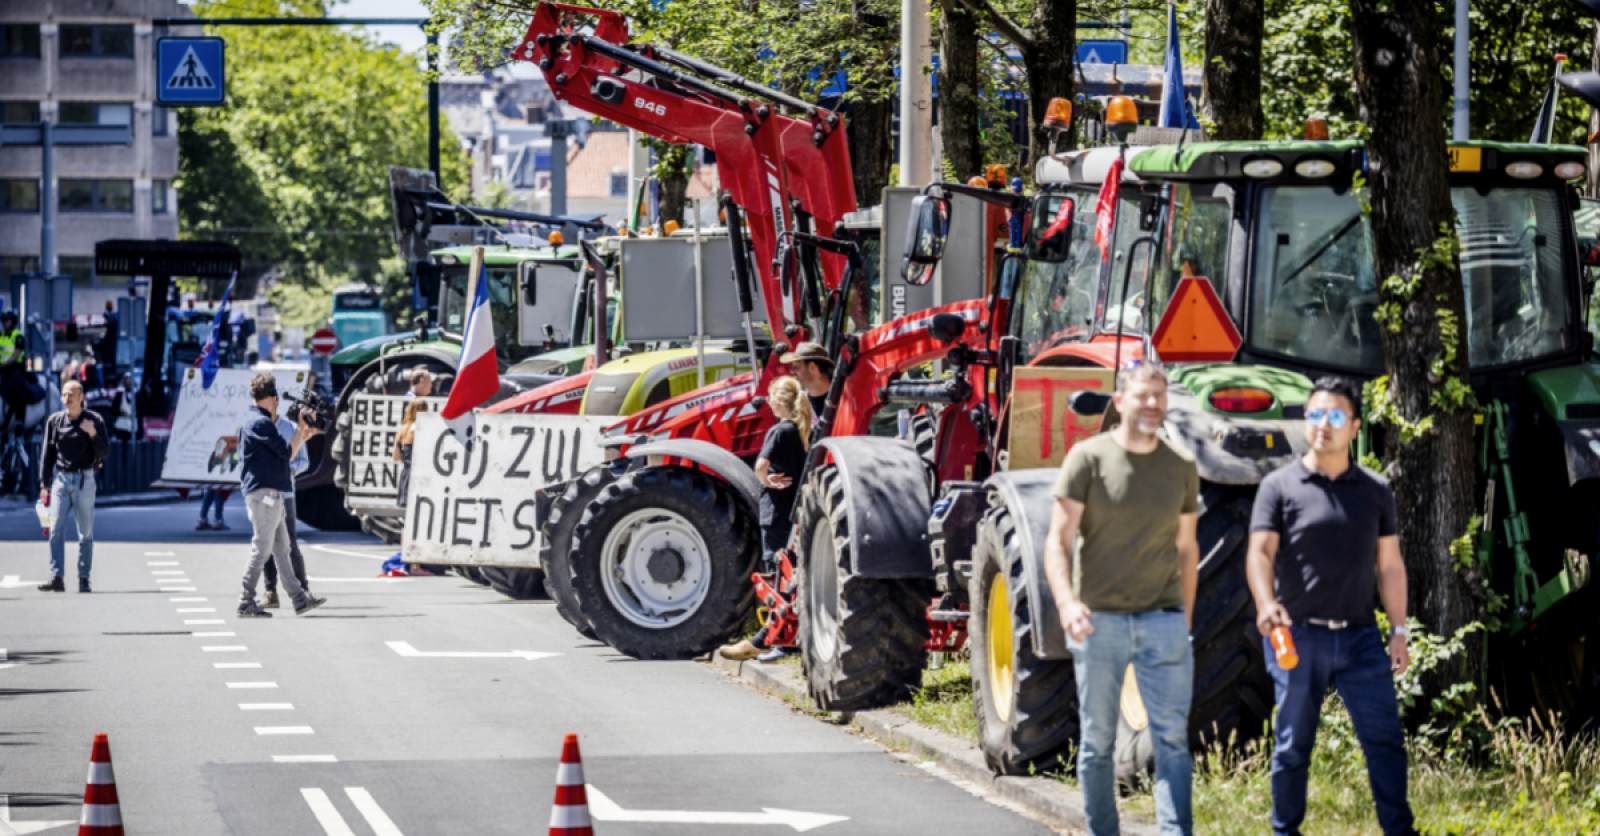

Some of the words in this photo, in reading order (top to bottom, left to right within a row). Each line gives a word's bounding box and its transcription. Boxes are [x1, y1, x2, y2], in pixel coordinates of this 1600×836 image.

[634, 96, 667, 116] 946
[667, 356, 698, 372] CLAAS
[503, 426, 607, 482] ZUL
